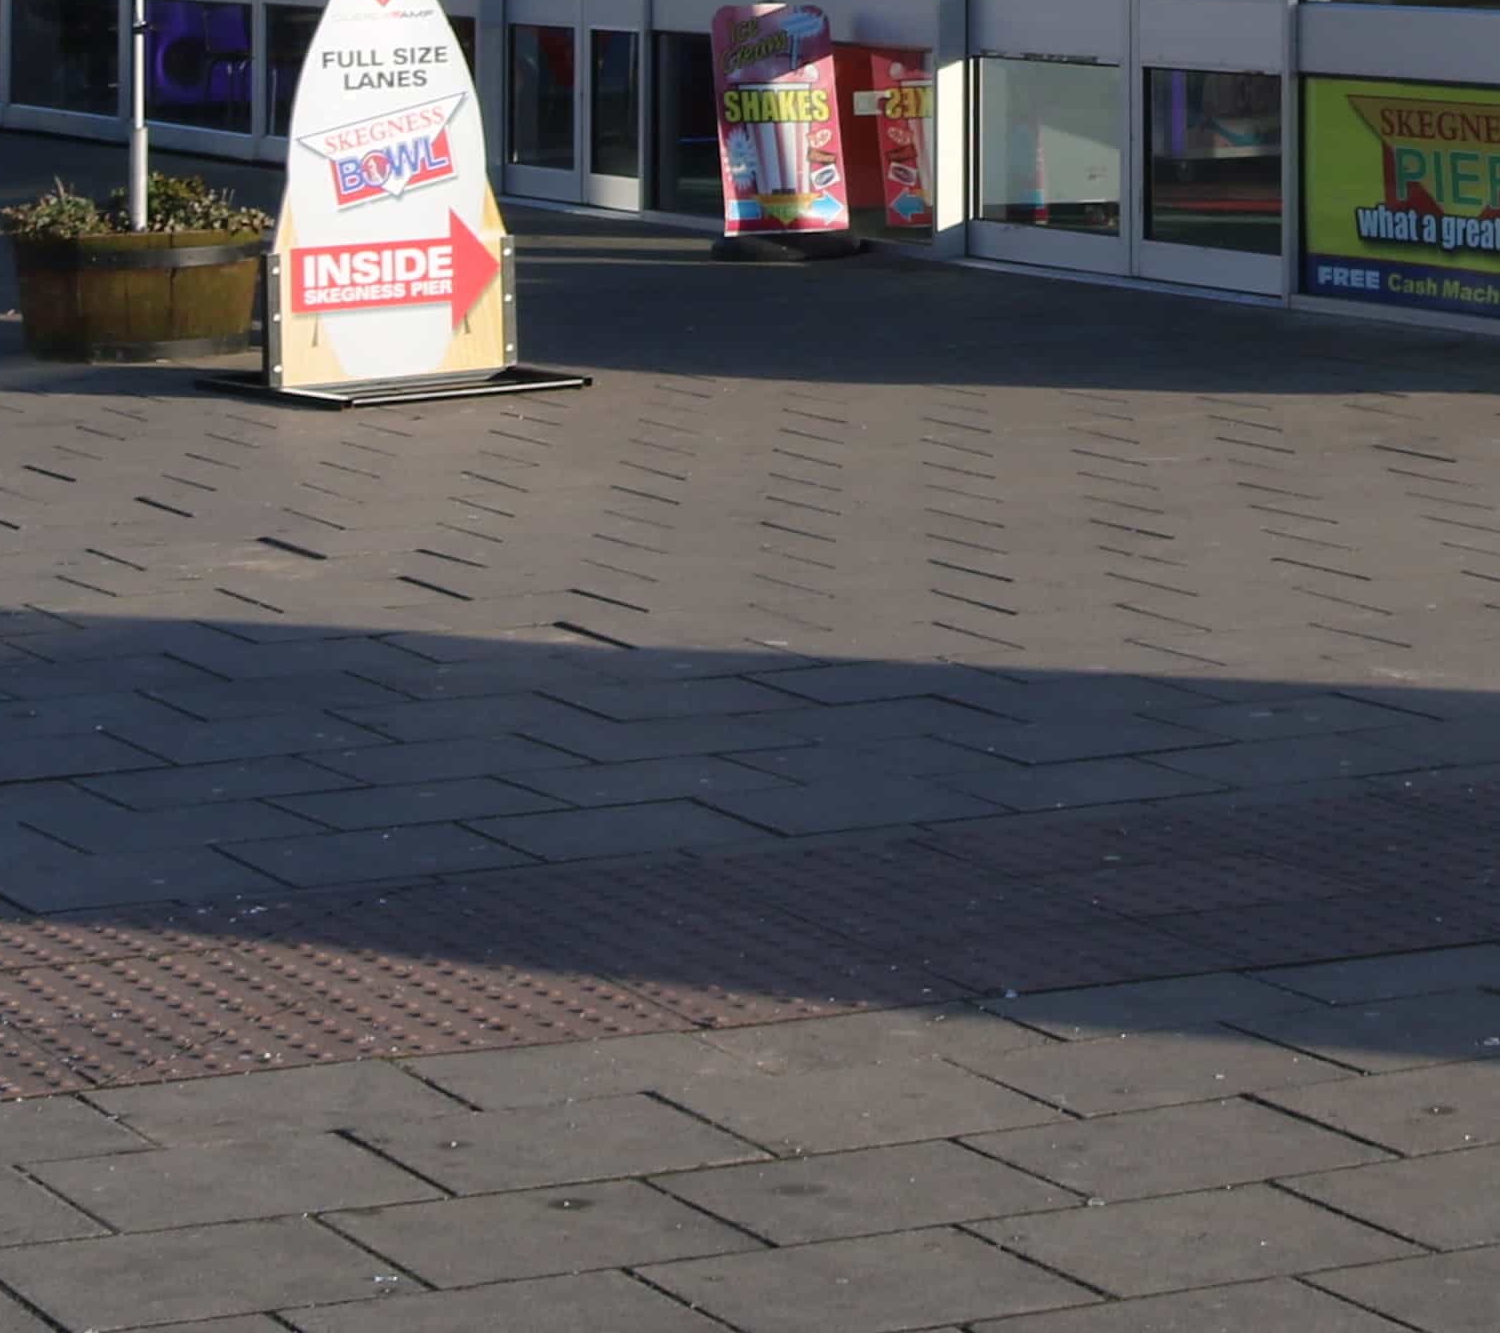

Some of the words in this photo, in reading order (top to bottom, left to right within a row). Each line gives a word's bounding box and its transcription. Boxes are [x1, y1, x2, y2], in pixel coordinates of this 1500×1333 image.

[321, 47, 386, 69] FULL
[393, 44, 448, 65] SIZE
[343, 69, 428, 91] LANES
[723, 89, 830, 123] SHAKES
[324, 105, 445, 156] SKEGNESS
[339, 133, 449, 194] BOWL
[1357, 205, 1418, 241] what
[1422, 217, 1436, 243] a
[302, 245, 453, 290] INSIDE
[1317, 266, 1380, 289] FREE
[1387, 274, 1438, 297] Cash
[304, 283, 406, 306] SKEGNESS
[410, 279, 453, 298] PIER
